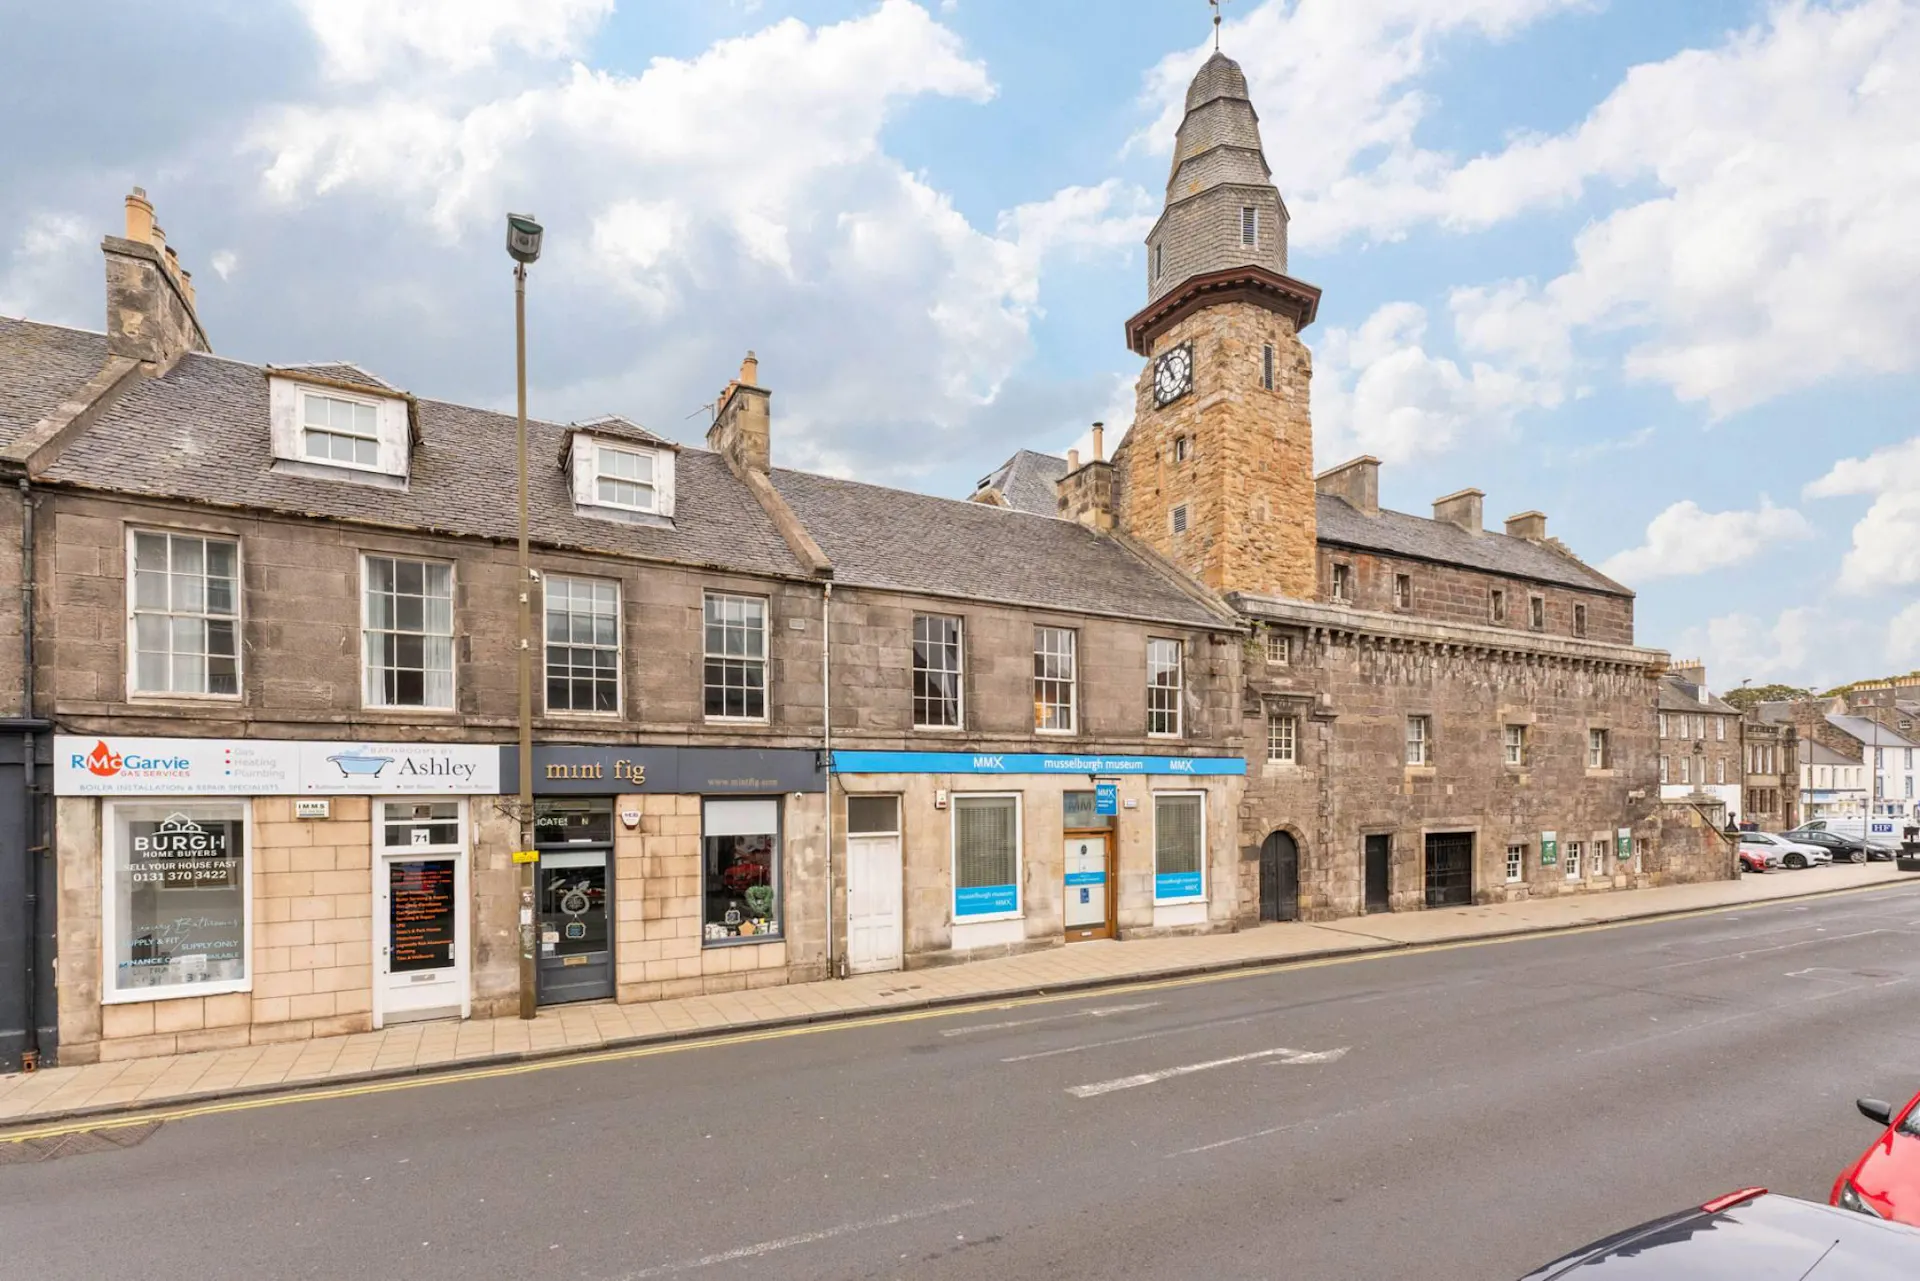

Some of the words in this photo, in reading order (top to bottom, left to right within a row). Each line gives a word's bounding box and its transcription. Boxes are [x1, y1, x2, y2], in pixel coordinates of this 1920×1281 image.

[235, 759, 276, 769] Heating
[398, 757, 477, 781] Ashley
[973, 757, 1005, 770] MMX
[1044, 758, 1103, 771] musselburgh
[1105, 760, 1143, 769] museum
[1170, 760, 1196, 772] MMX
[234, 769, 285, 780] Plumbing
[546, 762, 603, 779] mint
[614, 759, 646, 785] fig
[135, 835, 226, 851] BURGH
[414, 834, 427, 843] 71
[149, 862, 176, 870] YOUR
[178, 861, 212, 869] HOUSE
[214, 860, 237, 869] FAST
[133, 872, 165, 882] 0131
[167, 871, 192, 880] 370
[195, 870, 227, 879] 3422
[181, 941, 213, 950] SUPPLY
[214, 940, 239, 948] ONLY
